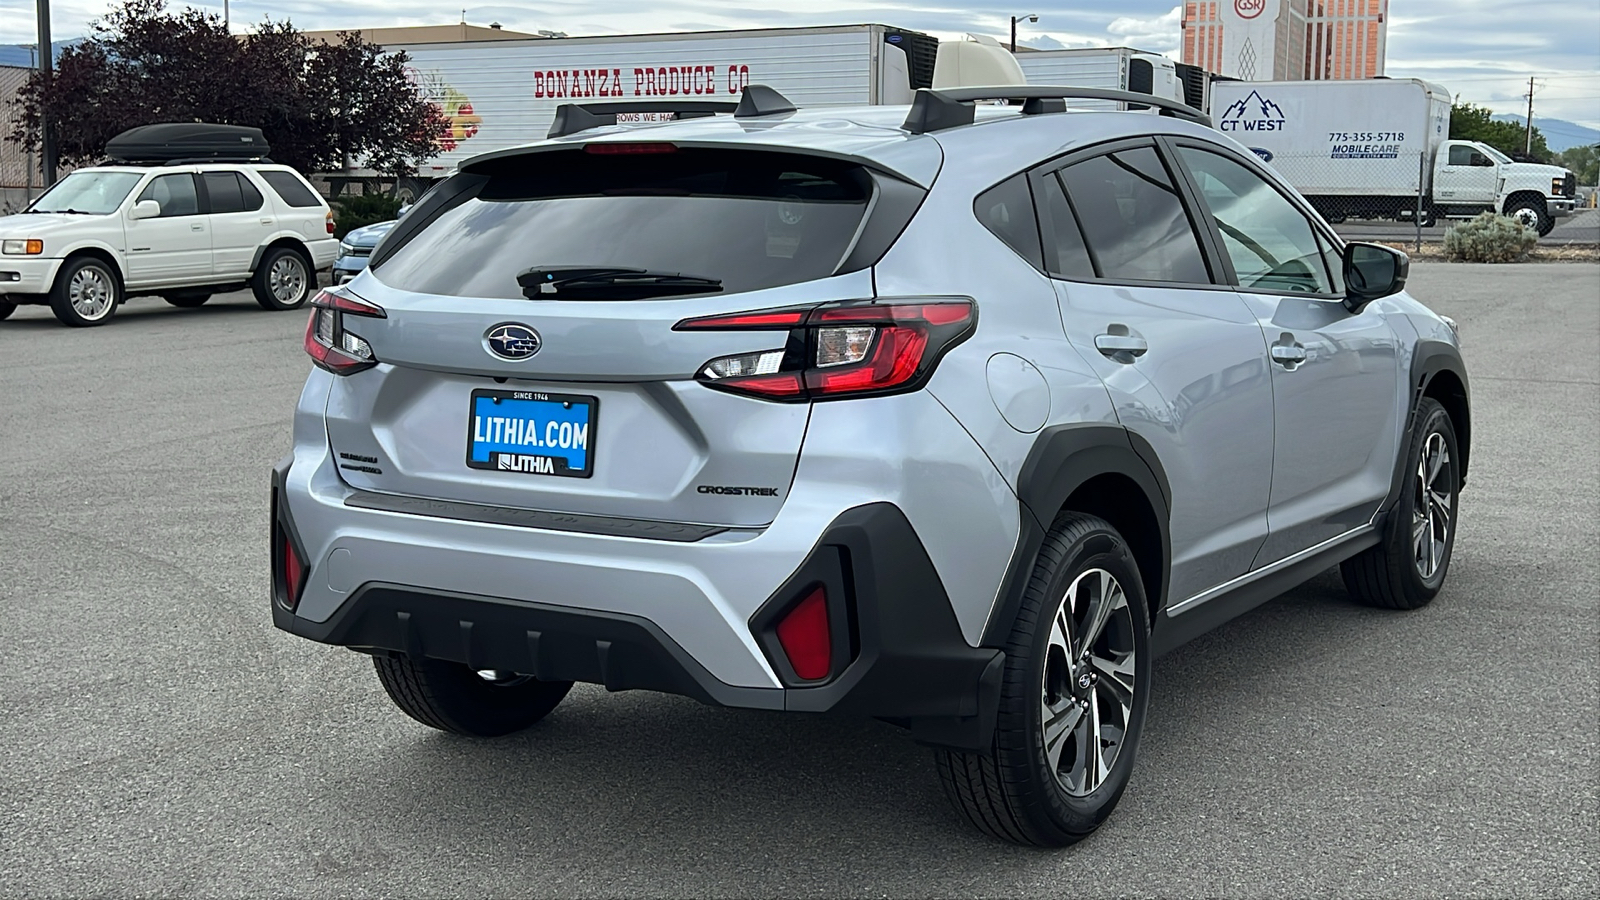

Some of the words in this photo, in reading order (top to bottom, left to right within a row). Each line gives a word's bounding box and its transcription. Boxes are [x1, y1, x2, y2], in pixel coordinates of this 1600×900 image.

[1238, 0, 1260, 10] GSR
[534, 68, 623, 98] BONANZA
[634, 66, 715, 96] PRODUCE
[728, 65, 749, 94] CO
[643, 112, 656, 122] WE
[660, 112, 674, 122] HA
[1220, 120, 1239, 131] CT
[1243, 120, 1285, 131] WEST
[1329, 132, 1404, 141] 775-355-5718
[513, 392, 532, 400] SINCE
[534, 393, 548, 401] 1946
[474, 415, 588, 450] LITHIA.COM
[511, 454, 554, 474] LITHIA
[696, 485, 779, 496] CROSSTREK
